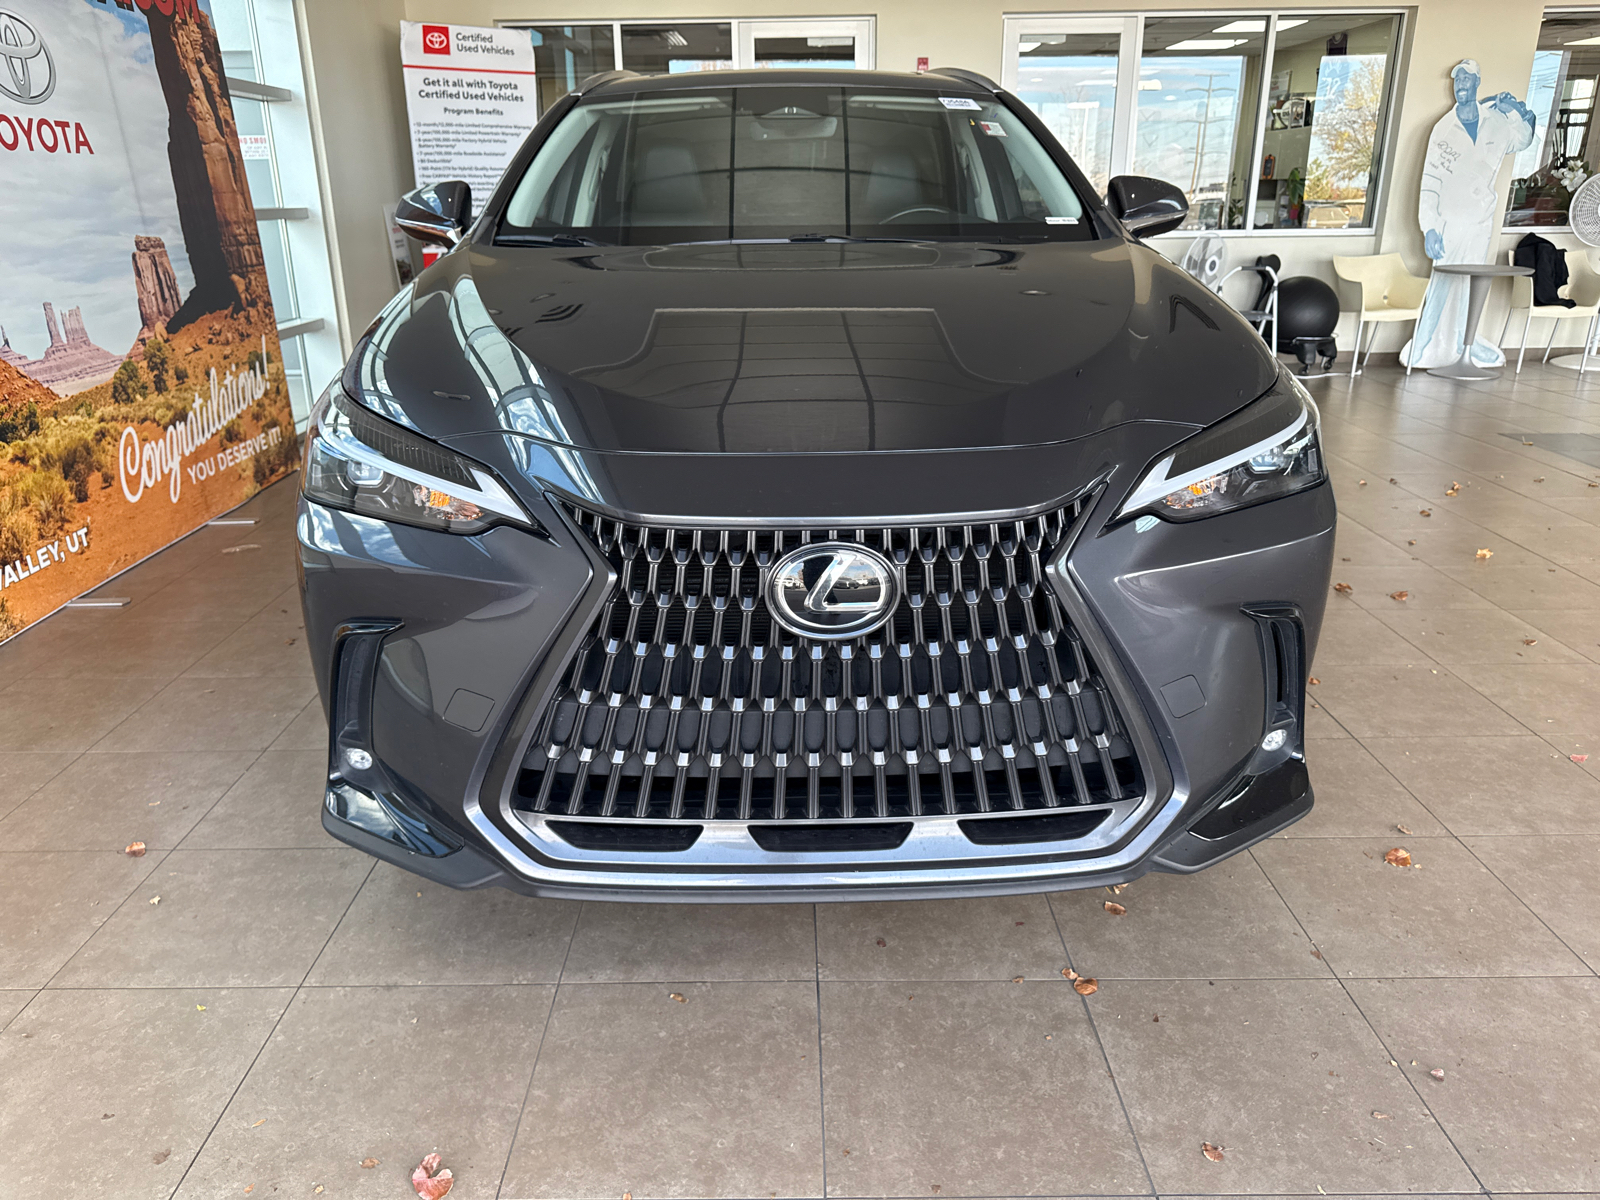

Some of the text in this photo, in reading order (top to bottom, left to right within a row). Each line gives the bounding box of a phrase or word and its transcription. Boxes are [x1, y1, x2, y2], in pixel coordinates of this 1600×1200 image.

[456, 32, 493, 43] Certified
[456, 43, 515, 56] Used Vehicles
[423, 77, 518, 91] Get it all with Toyota
[418, 90, 524, 102] Certified Used Vehicles
[443, 107, 504, 116] Program Benefits
[0, 114, 94, 154] OYOTA
[119, 334, 270, 503] Congratulations!
[187, 426, 282, 484] YOU DESERVE IT!
[66, 527, 88, 553] UT
